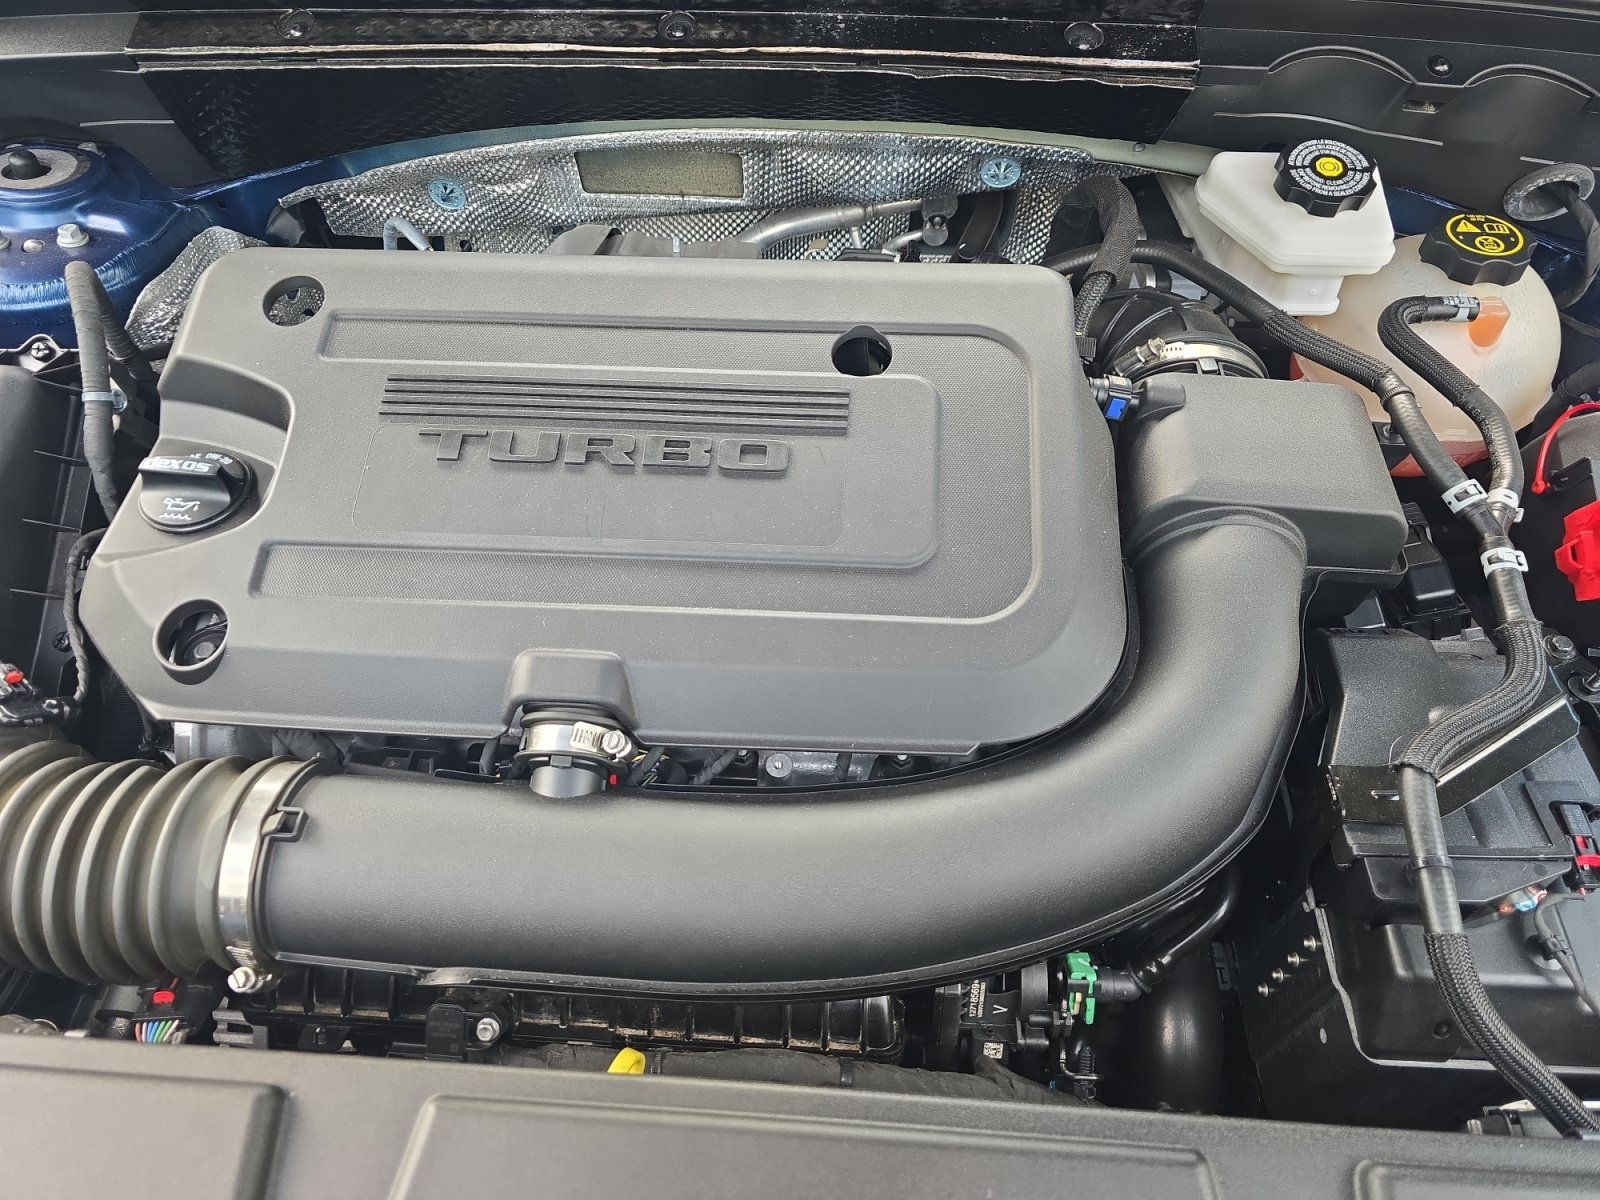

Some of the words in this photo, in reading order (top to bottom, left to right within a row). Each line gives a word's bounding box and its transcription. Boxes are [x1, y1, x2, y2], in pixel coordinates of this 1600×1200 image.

[143, 456, 212, 472] dexos
[417, 427, 792, 475] TURBO
[969, 983, 980, 1017] 12718569
